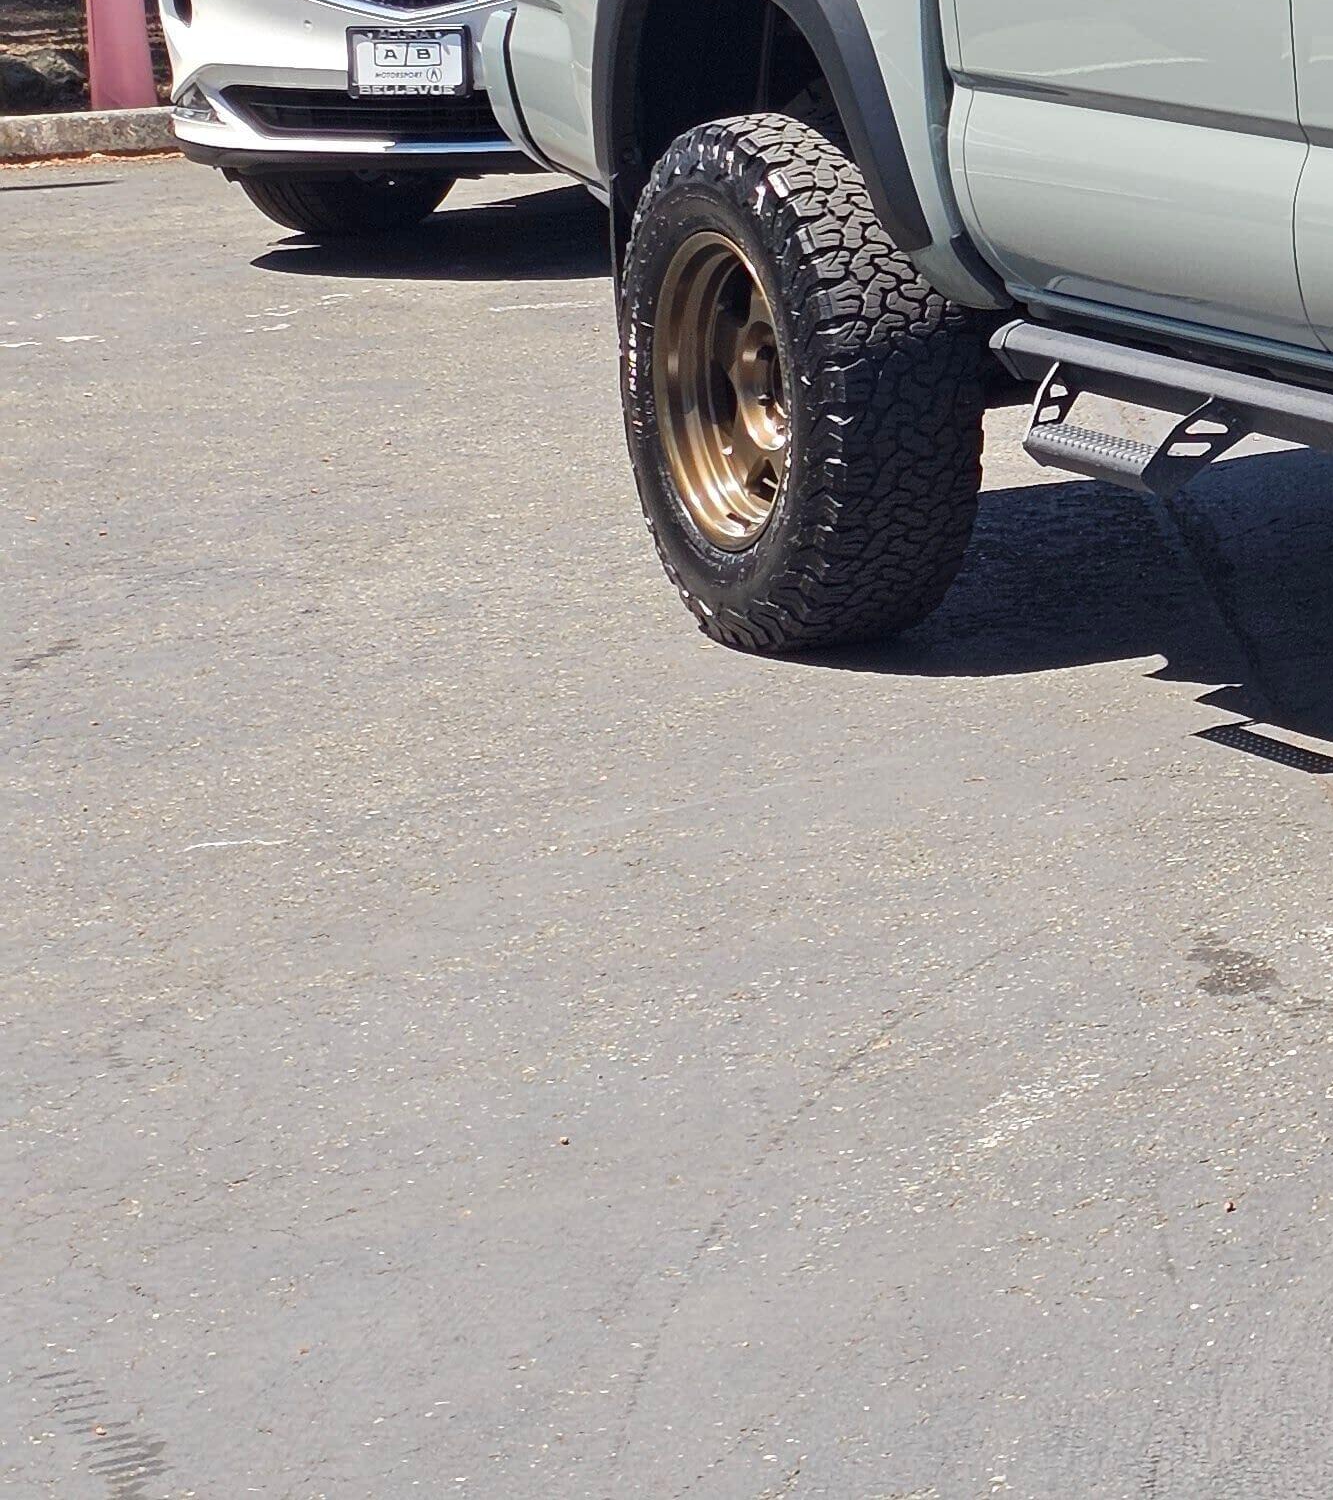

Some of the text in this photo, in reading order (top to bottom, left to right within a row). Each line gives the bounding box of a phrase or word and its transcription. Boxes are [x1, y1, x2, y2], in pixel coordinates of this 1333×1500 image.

[384, 49, 431, 59] A B
[359, 85, 455, 95] BELLEVUE
